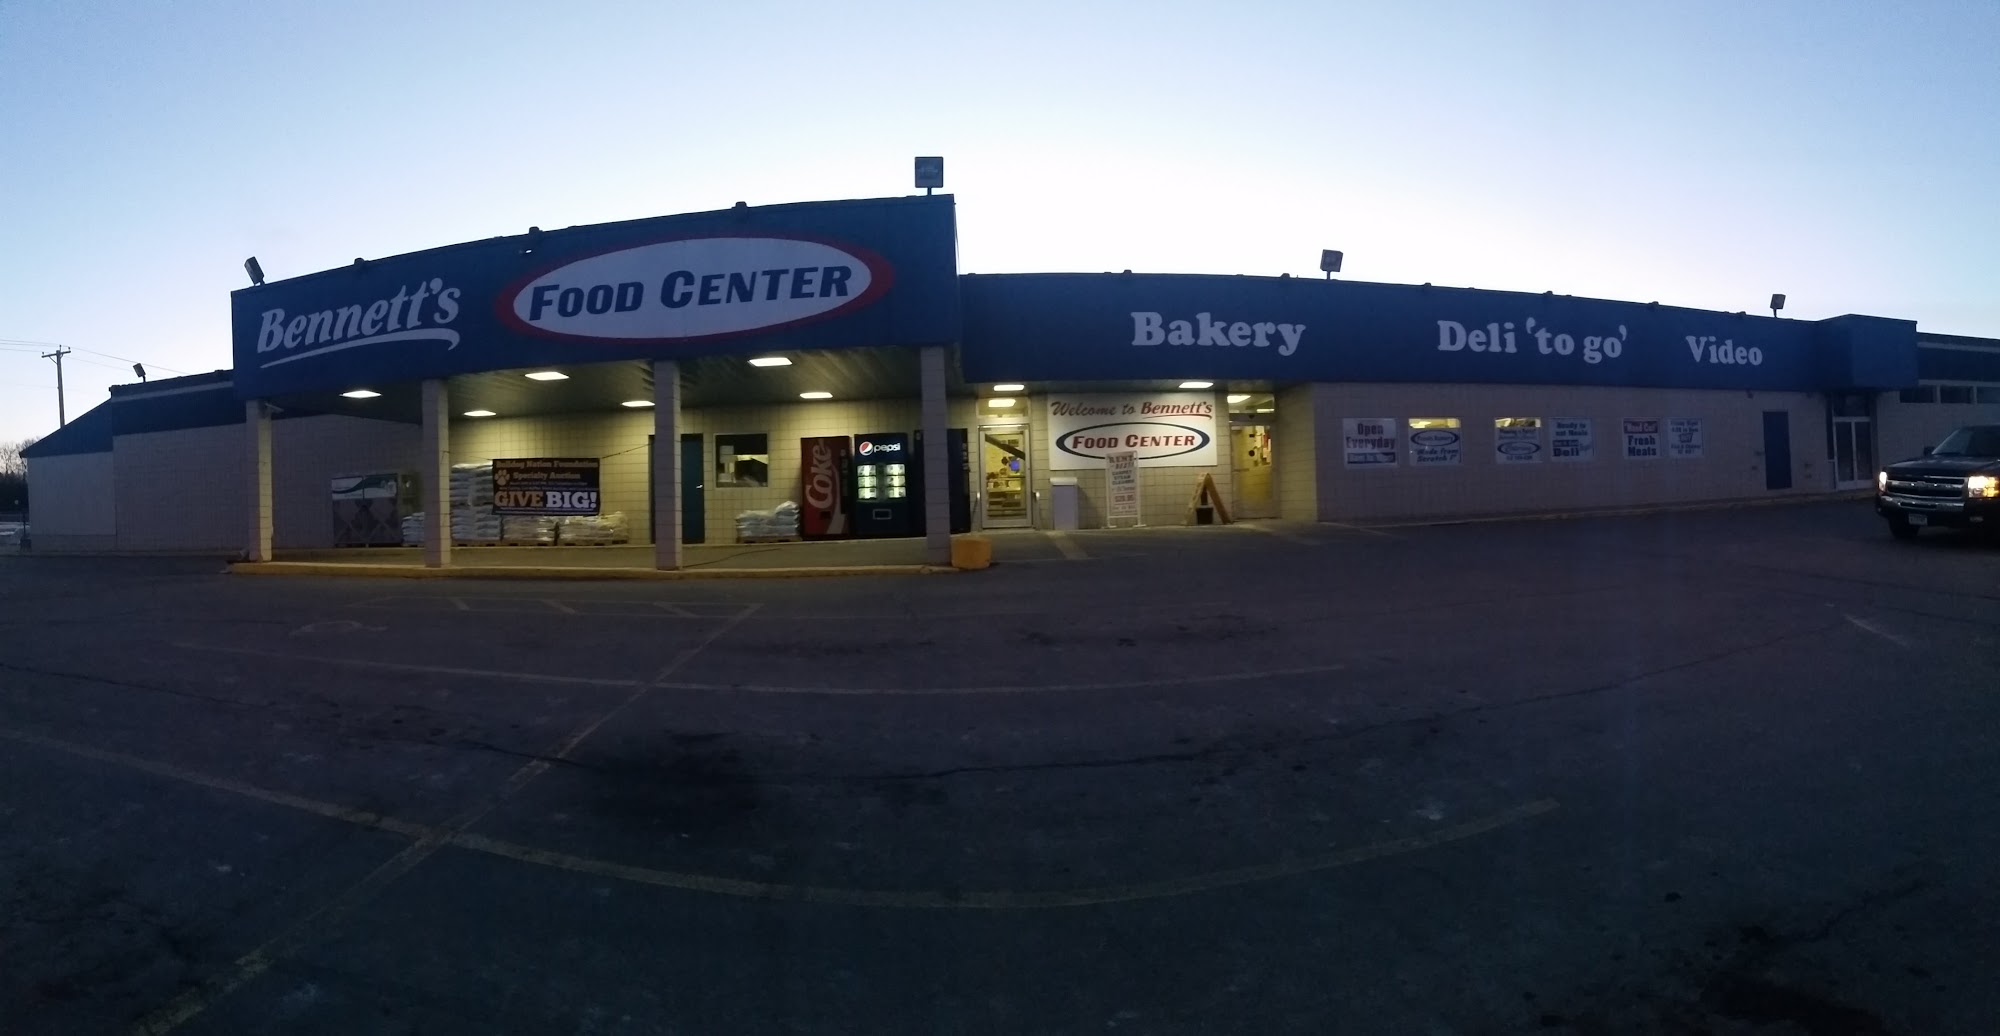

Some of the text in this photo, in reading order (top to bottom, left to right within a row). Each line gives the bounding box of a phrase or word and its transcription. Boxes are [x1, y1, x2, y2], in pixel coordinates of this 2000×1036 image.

[529, 265, 852, 321] FOOD CENTER
[257, 277, 461, 353] Bennett's
[1130, 311, 1306, 356] Bakery
[1437, 320, 1517, 353] Deli
[1686, 335, 1763, 365] Video
[1050, 401, 1212, 416] Welcome to Bennett's
[1357, 423, 1384, 437] Open
[873, 442, 901, 453] pepsi
[1072, 434, 1195, 449] FOOD CENTER
[1346, 436, 1396, 449] Everyday
[1628, 435, 1656, 445] Fresh
[1553, 448, 1580, 456] Deli
[1628, 447, 1657, 456] Meats
[805, 438, 833, 509] Coke
[494, 491, 597, 508] GIVE BIG!
